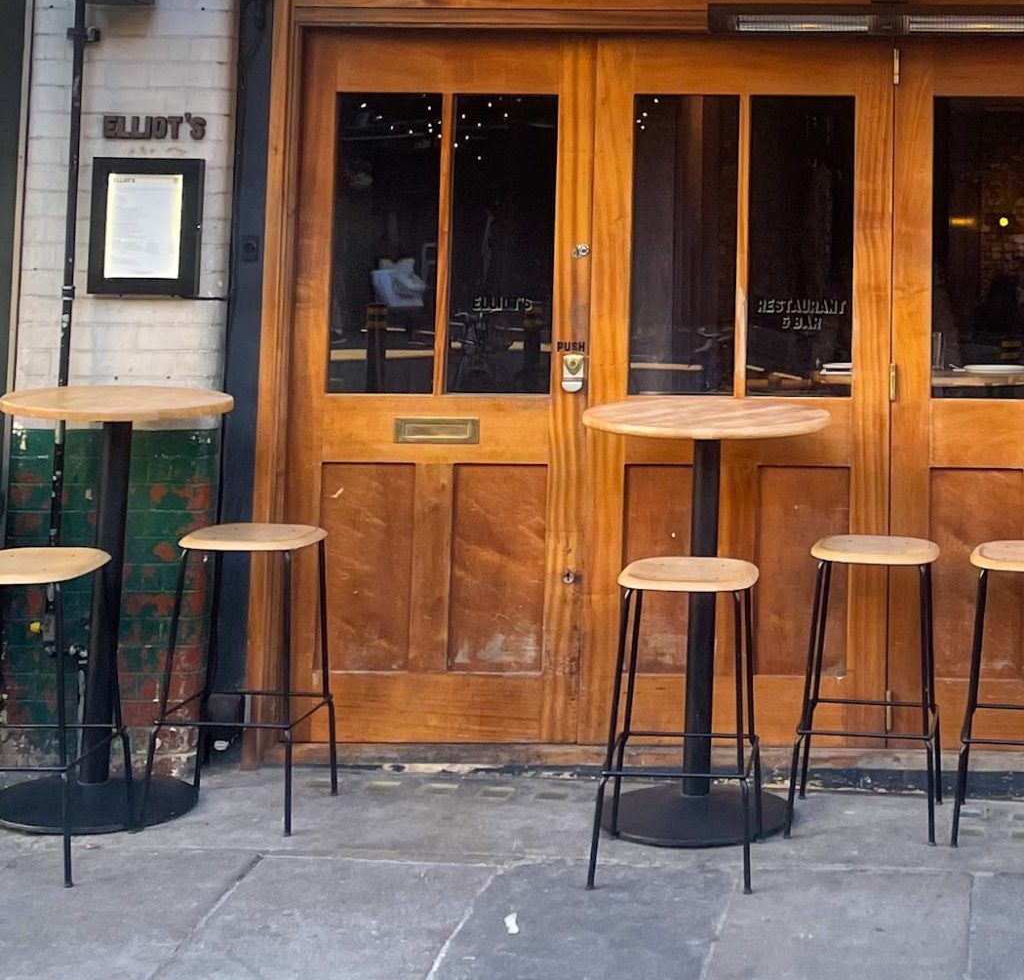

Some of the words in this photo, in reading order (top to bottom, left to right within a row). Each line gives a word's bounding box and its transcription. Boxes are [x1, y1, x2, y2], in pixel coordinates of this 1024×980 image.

[103, 112, 207, 141] ELLIOT'S
[756, 298, 847, 315] RESTAURANT
[792, 316, 823, 330] BAR
[557, 341, 585, 352] PUSH
